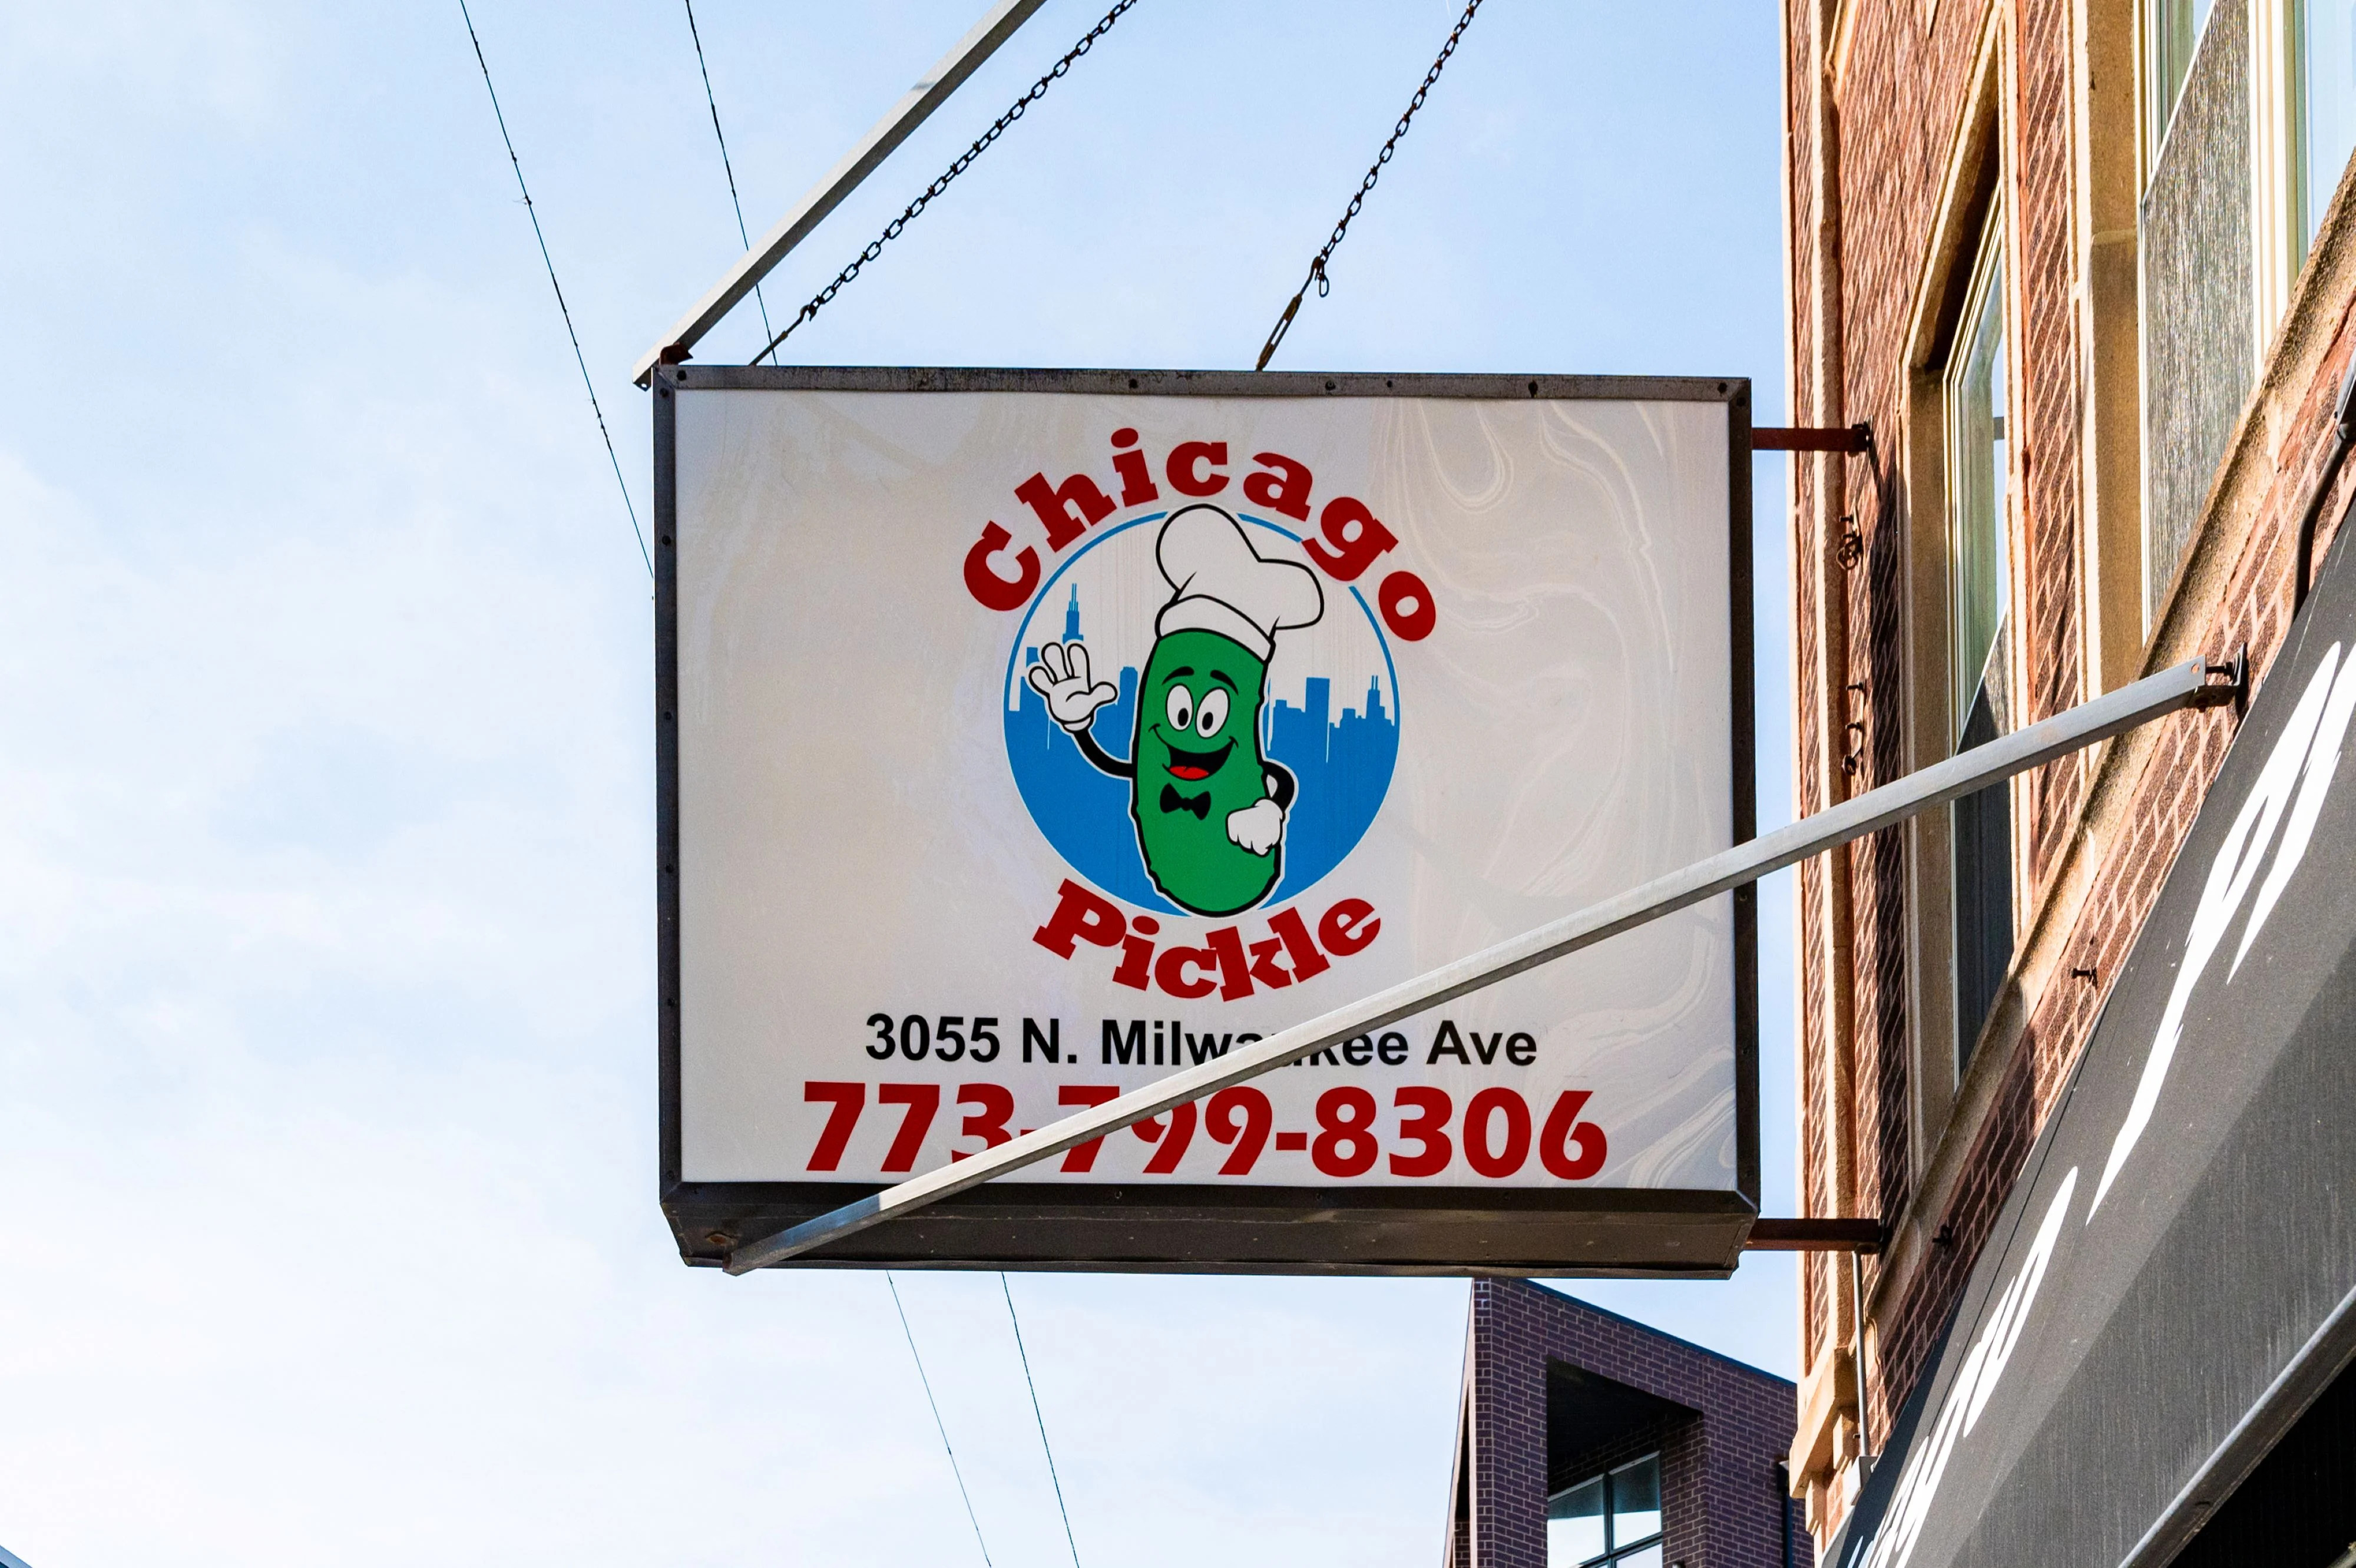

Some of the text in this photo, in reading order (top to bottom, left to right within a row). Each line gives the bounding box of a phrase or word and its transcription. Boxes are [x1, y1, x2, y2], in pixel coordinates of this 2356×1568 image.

[964, 428, 1437, 643] Chicago
[1033, 878, 1381, 1002] Pickle
[866, 1013, 1537, 1066] 3055 N. Milwee Ave
[803, 1081, 1607, 1180] 773799-8306
